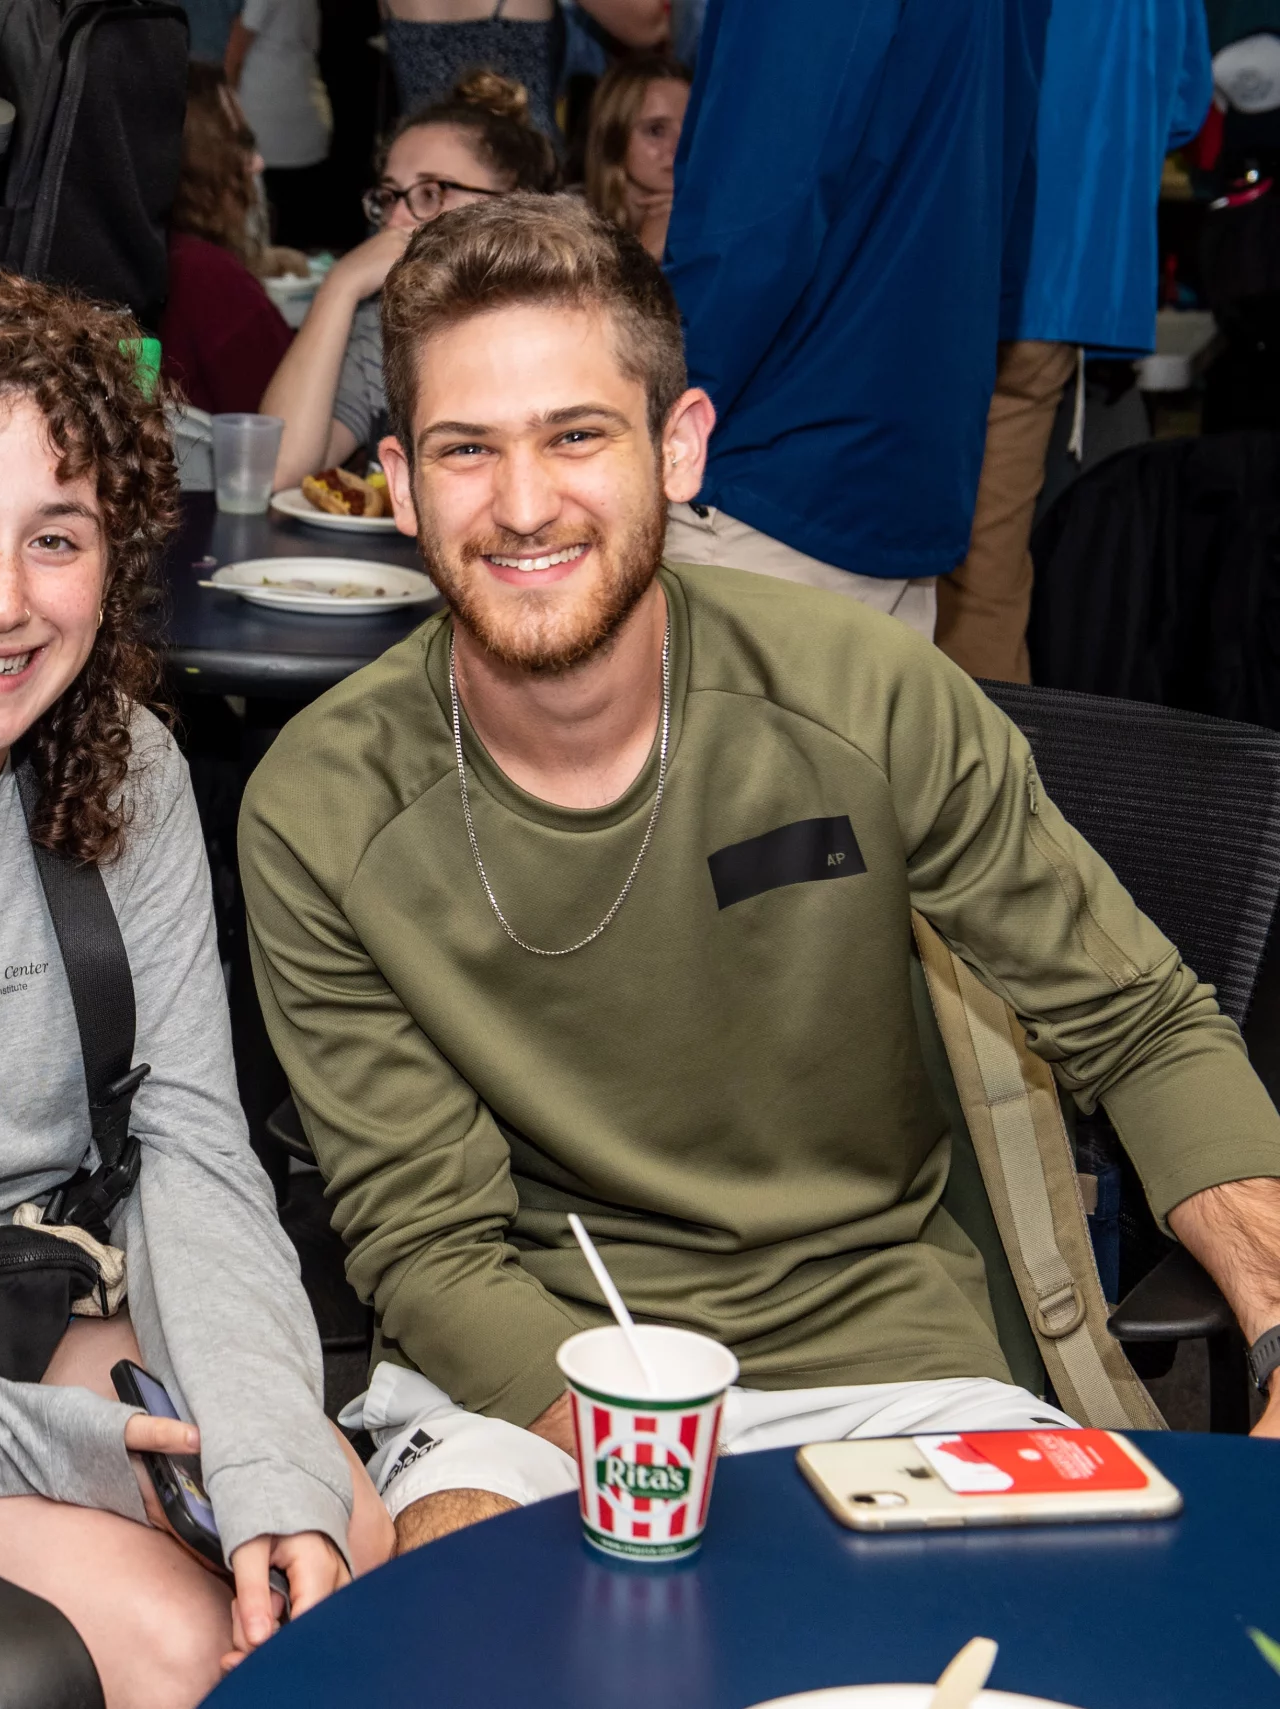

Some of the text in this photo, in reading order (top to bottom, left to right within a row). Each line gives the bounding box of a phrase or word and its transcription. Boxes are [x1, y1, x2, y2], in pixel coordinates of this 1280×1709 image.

[826, 852, 847, 867] AP
[4, 962, 49, 980] Center
[379, 1438, 444, 1497] adidas
[605, 1455, 686, 1492] Rita's
